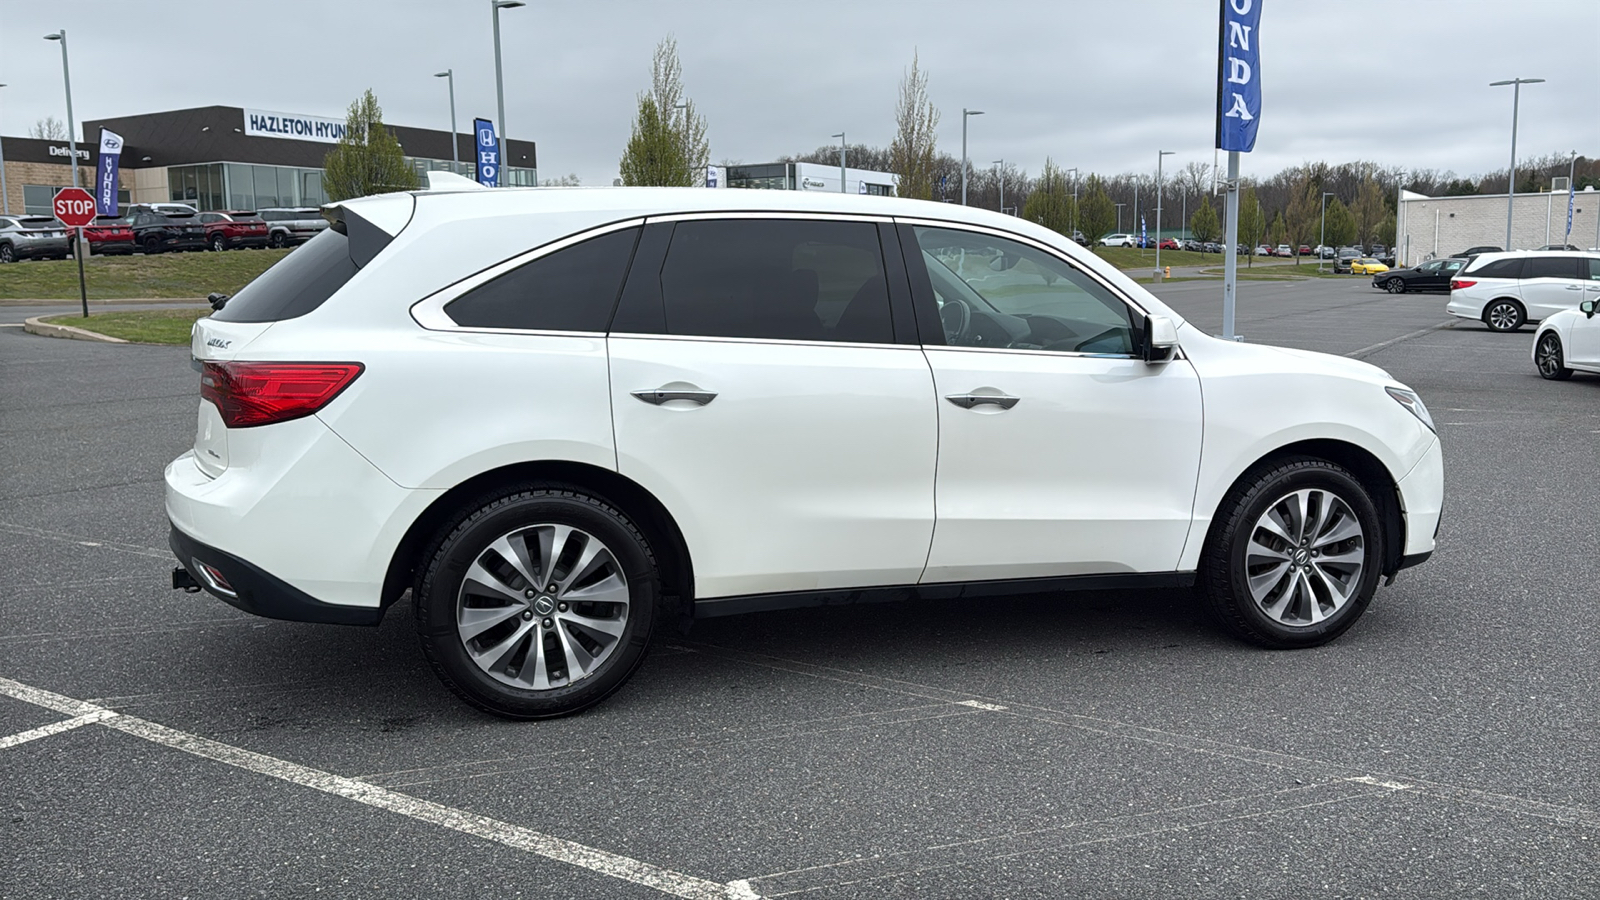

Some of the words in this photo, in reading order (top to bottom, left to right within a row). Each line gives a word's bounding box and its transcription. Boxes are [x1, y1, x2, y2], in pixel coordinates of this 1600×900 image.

[250, 114, 313, 136] HAZLETON
[315, 121, 364, 142] HYUN
[103, 156, 113, 213] HYUNDAI
[56, 200, 94, 215] STOP
